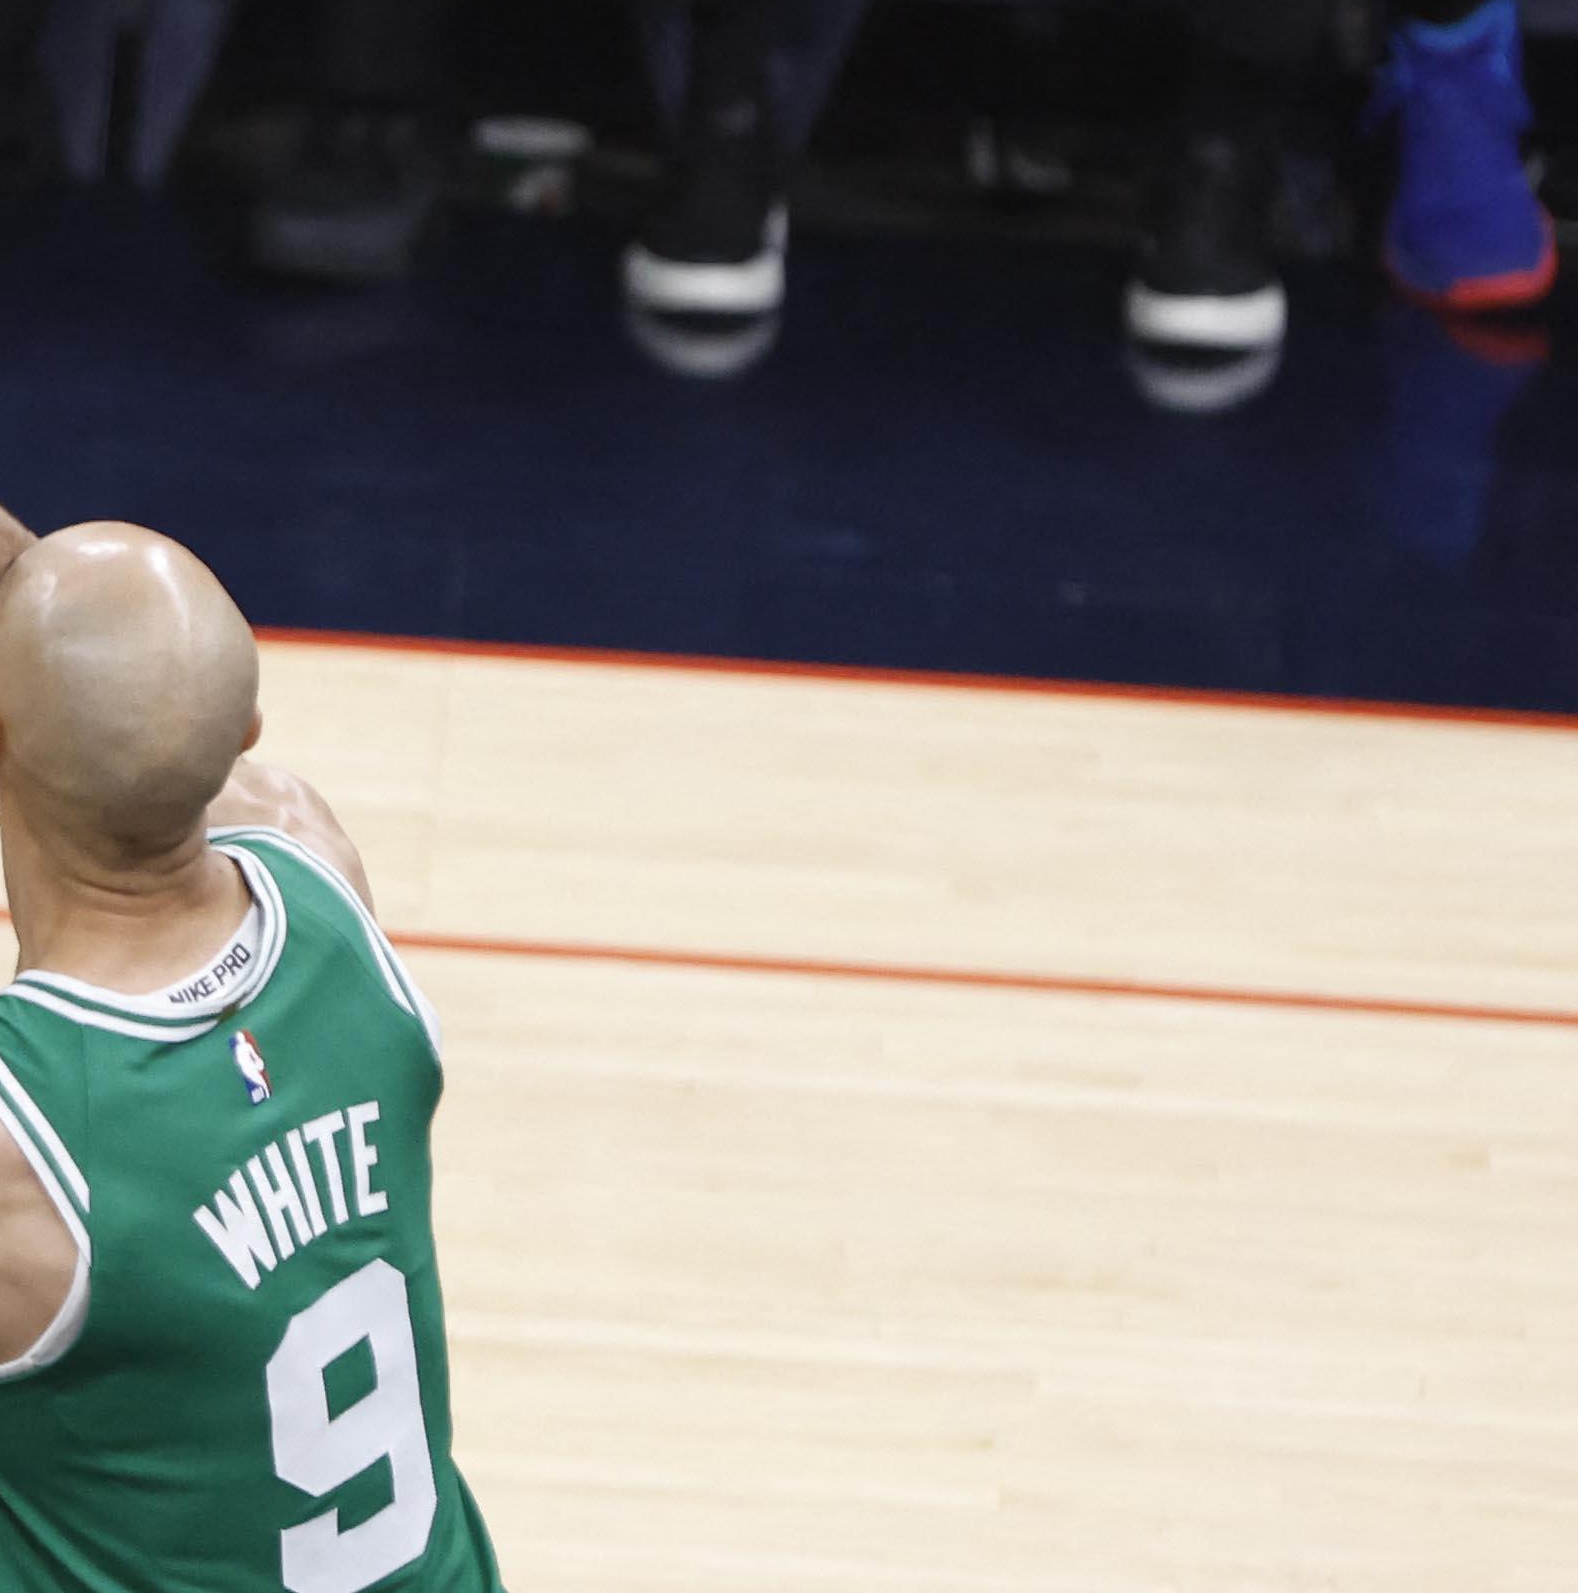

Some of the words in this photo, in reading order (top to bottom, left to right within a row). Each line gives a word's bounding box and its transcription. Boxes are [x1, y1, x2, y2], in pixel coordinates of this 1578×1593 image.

[168, 975, 217, 1004] NIKE
[212, 941, 252, 986] PRO
[191, 1101, 388, 1290] WHITE
[266, 1258, 438, 1593] 9
